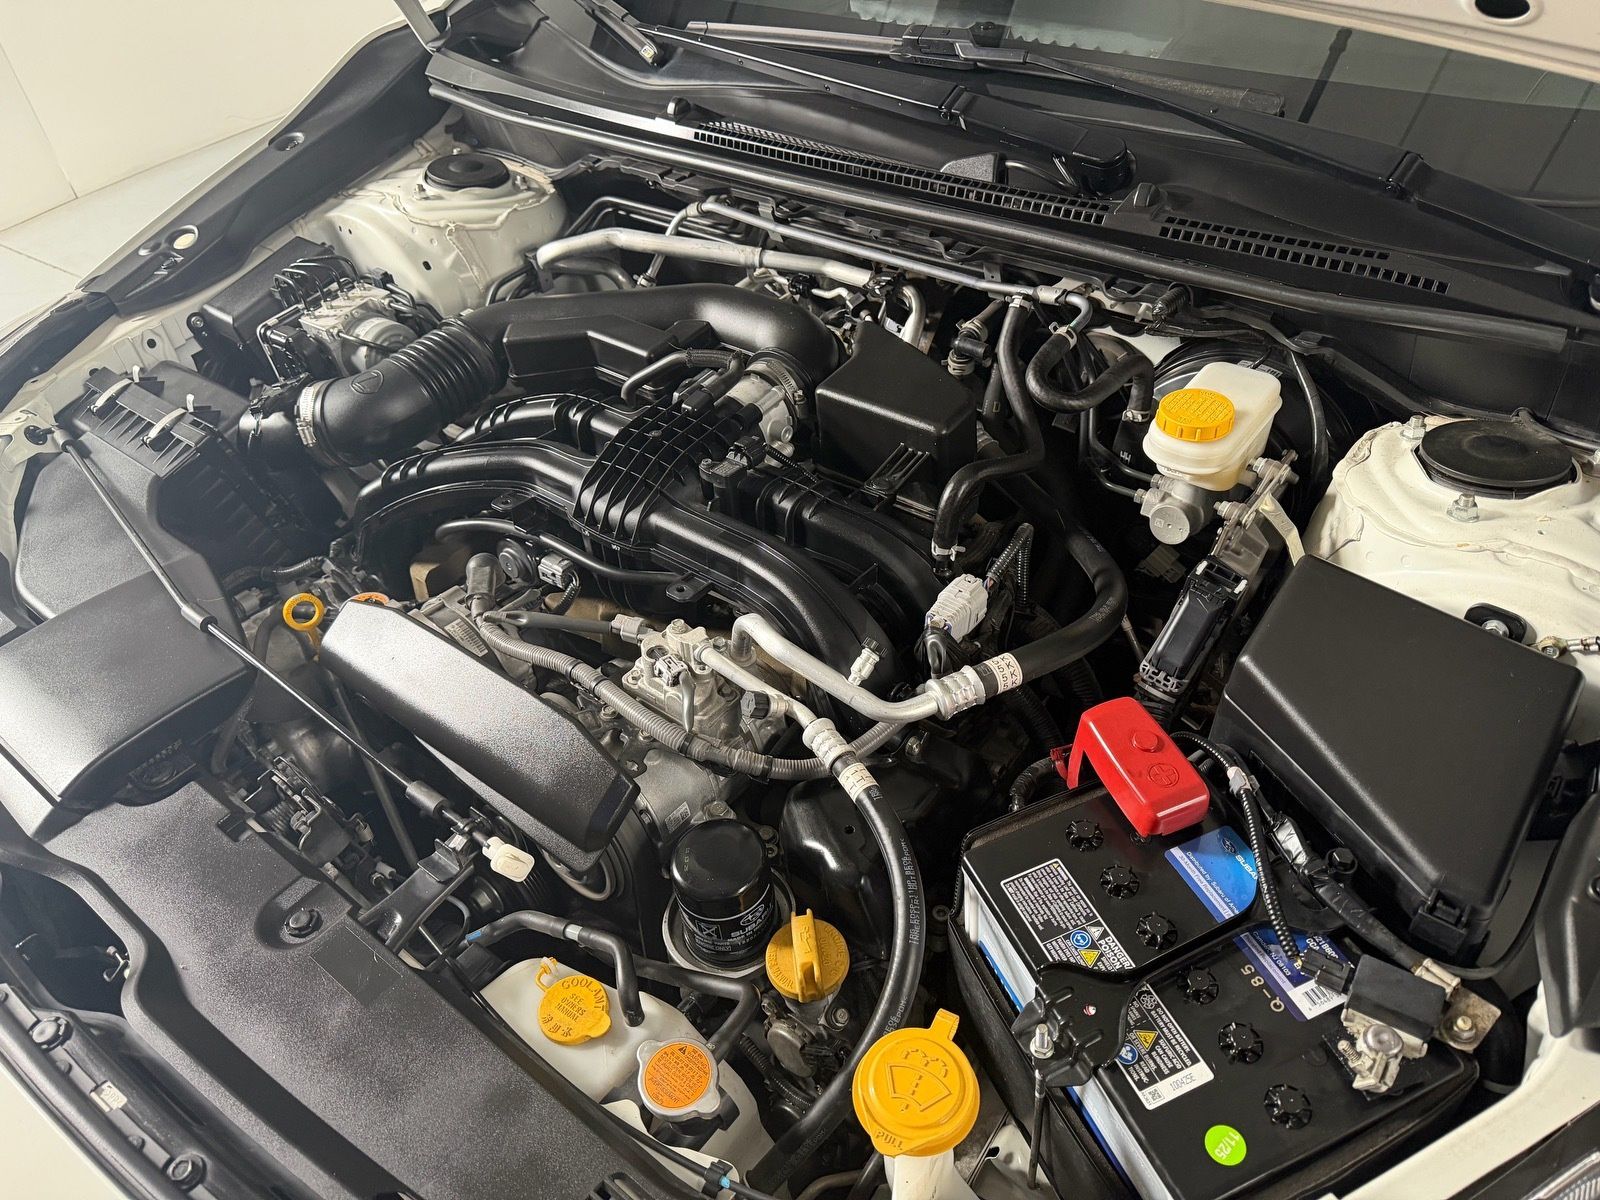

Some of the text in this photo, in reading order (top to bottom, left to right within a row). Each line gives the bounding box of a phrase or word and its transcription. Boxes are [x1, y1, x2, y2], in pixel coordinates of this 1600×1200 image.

[1098, 940, 1123, 969] POISON
[562, 978, 604, 1011] COOLANT
[570, 993, 584, 1004] SEE
[1166, 1022, 1177, 1034] OPEN
[875, 1130, 902, 1150] PULL
